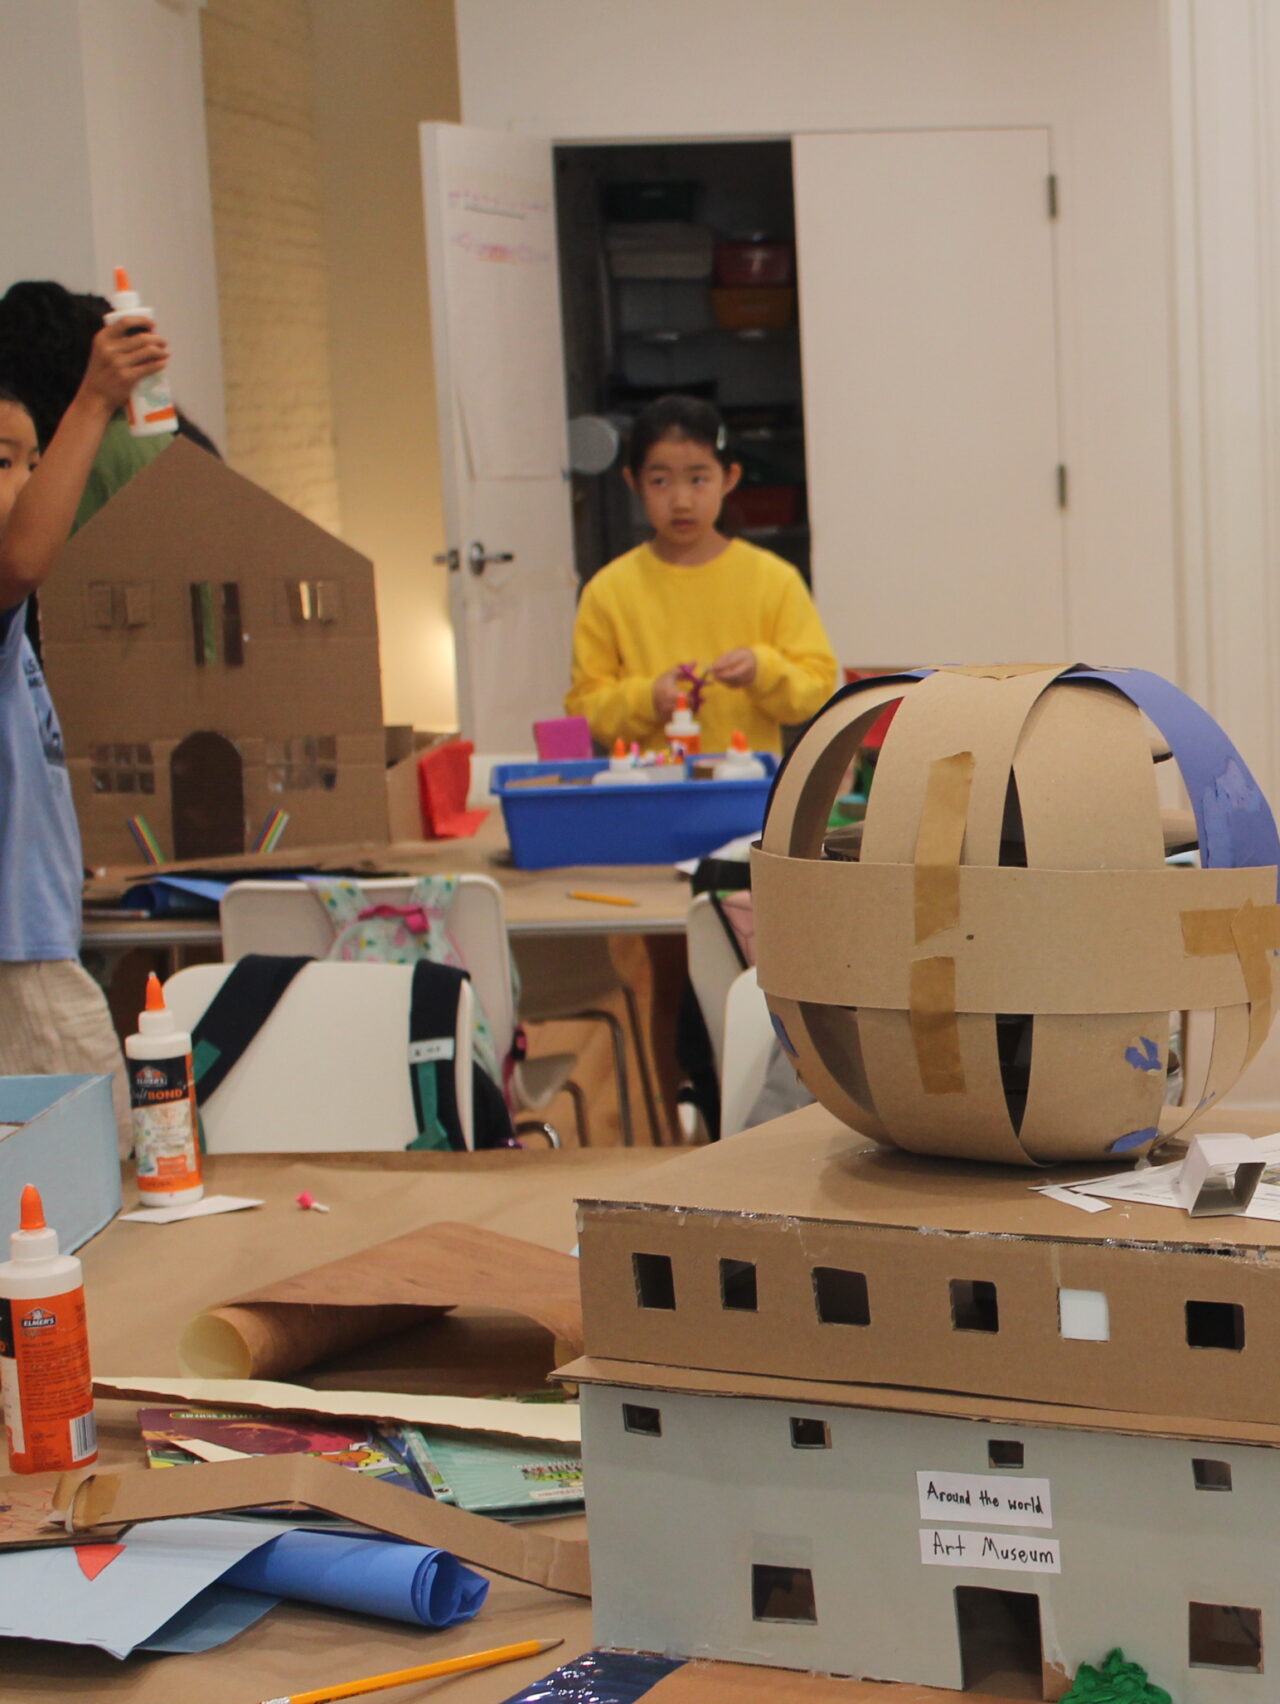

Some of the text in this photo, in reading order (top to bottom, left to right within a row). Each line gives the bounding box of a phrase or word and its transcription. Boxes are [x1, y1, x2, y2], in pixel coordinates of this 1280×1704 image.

[23, 1317, 54, 1327] ELMER'S
[927, 1481, 1043, 1514] Around the world
[933, 1531, 1055, 1564] Art Museum
